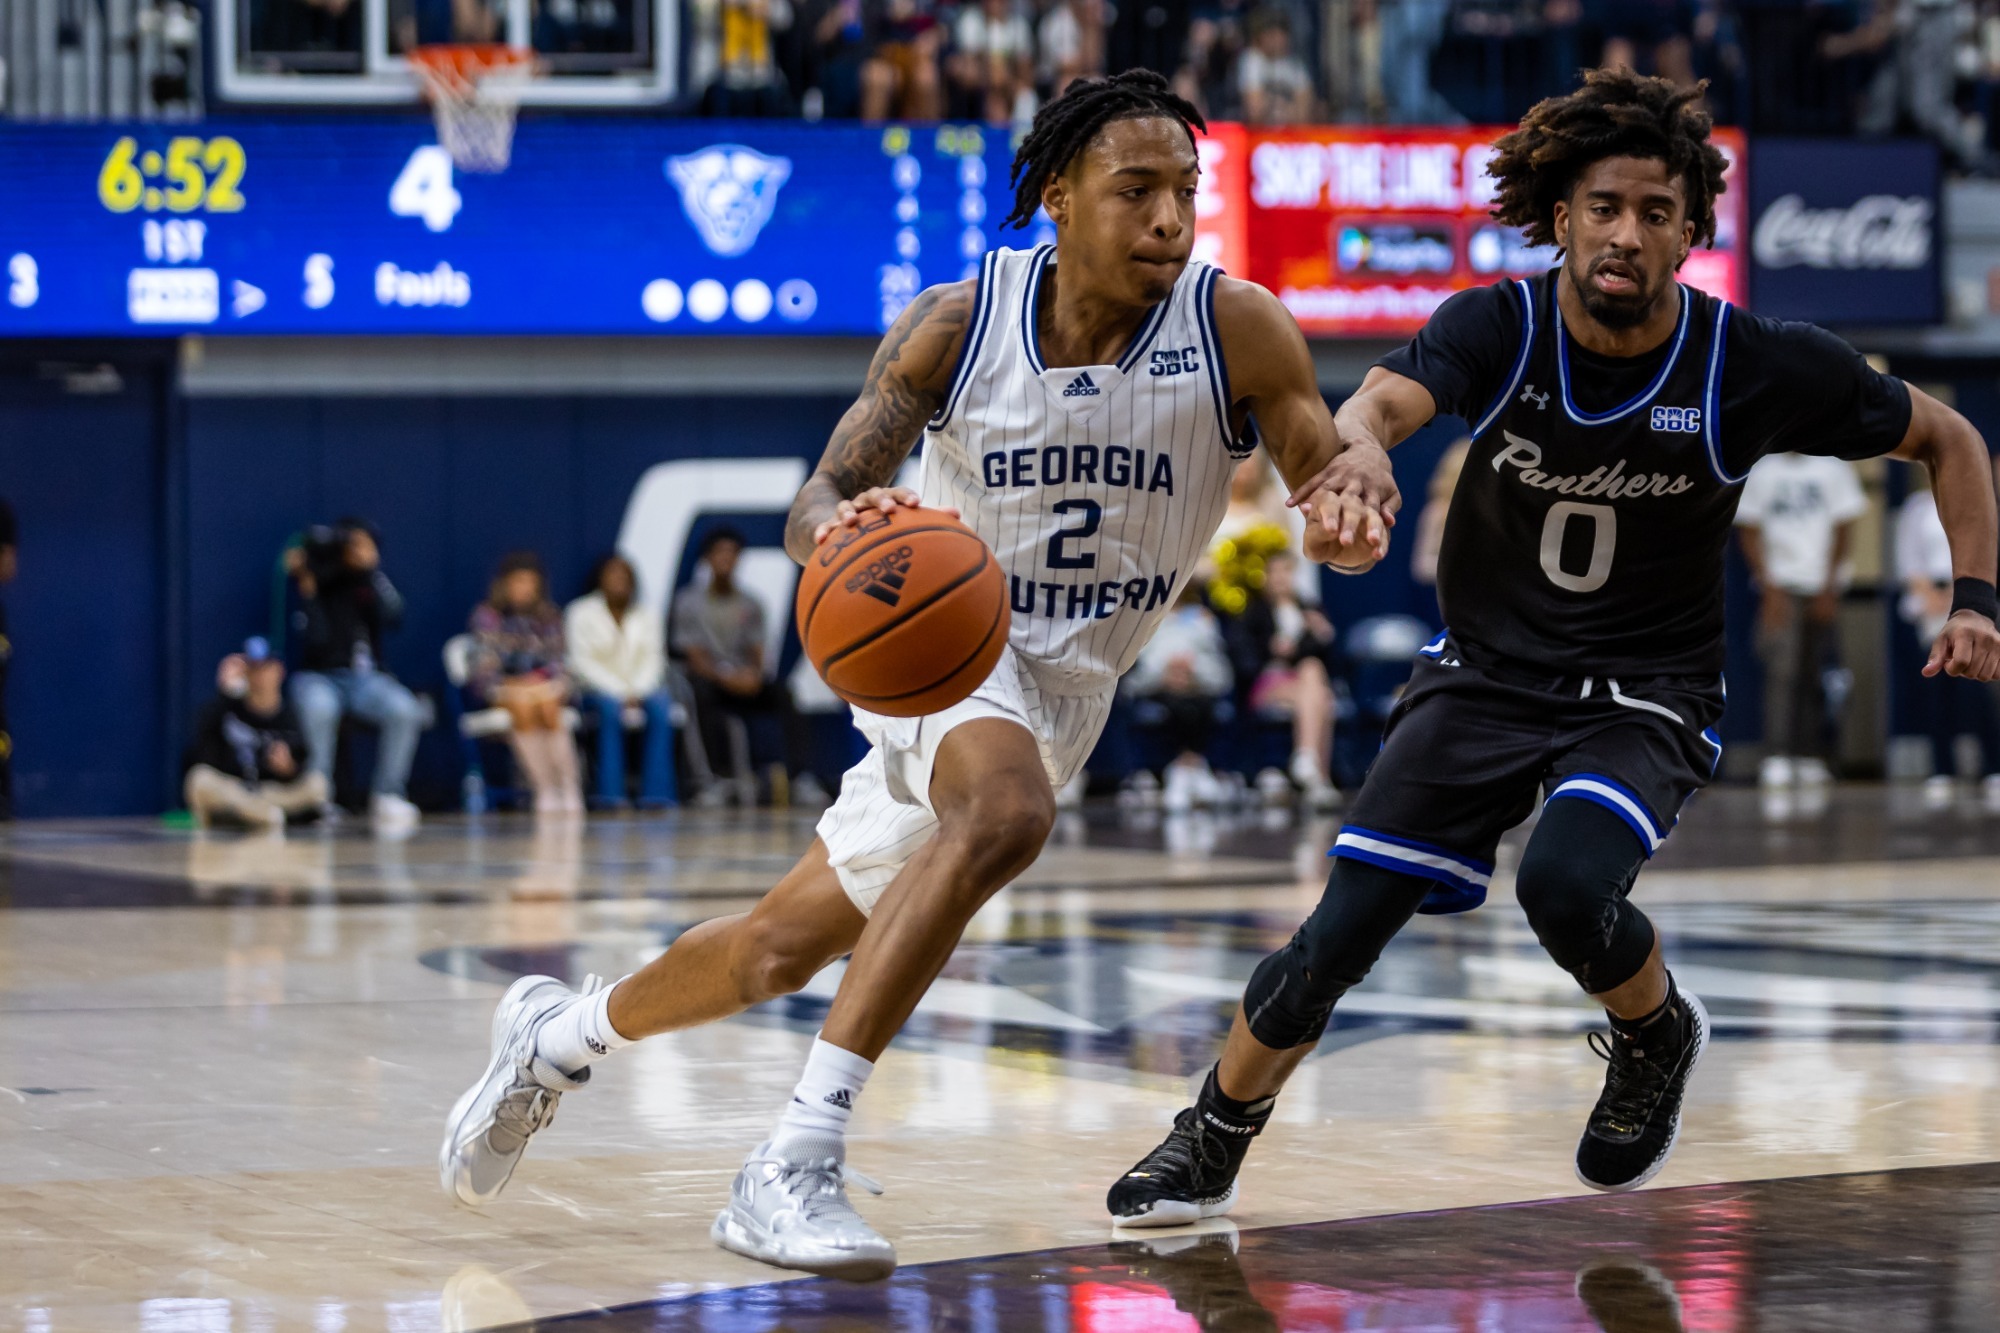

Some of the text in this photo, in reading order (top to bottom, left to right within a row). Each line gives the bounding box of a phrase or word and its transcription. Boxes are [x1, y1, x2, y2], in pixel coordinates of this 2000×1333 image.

[98, 137, 246, 212] 6:52
[389, 145, 462, 232] 4
[142, 218, 207, 262] 1ST
[1149, 346, 1200, 377] SBC
[1062, 386, 1101, 397] adidas
[1651, 406, 1700, 433] SBC
[983, 444, 1174, 497] GEORGIA
[1492, 429, 1695, 499] Panthers
[1046, 498, 1102, 569] 2
[1540, 500, 1617, 593] 0
[845, 545, 913, 594] adidas
[1010, 568, 1178, 619] UTHERN
